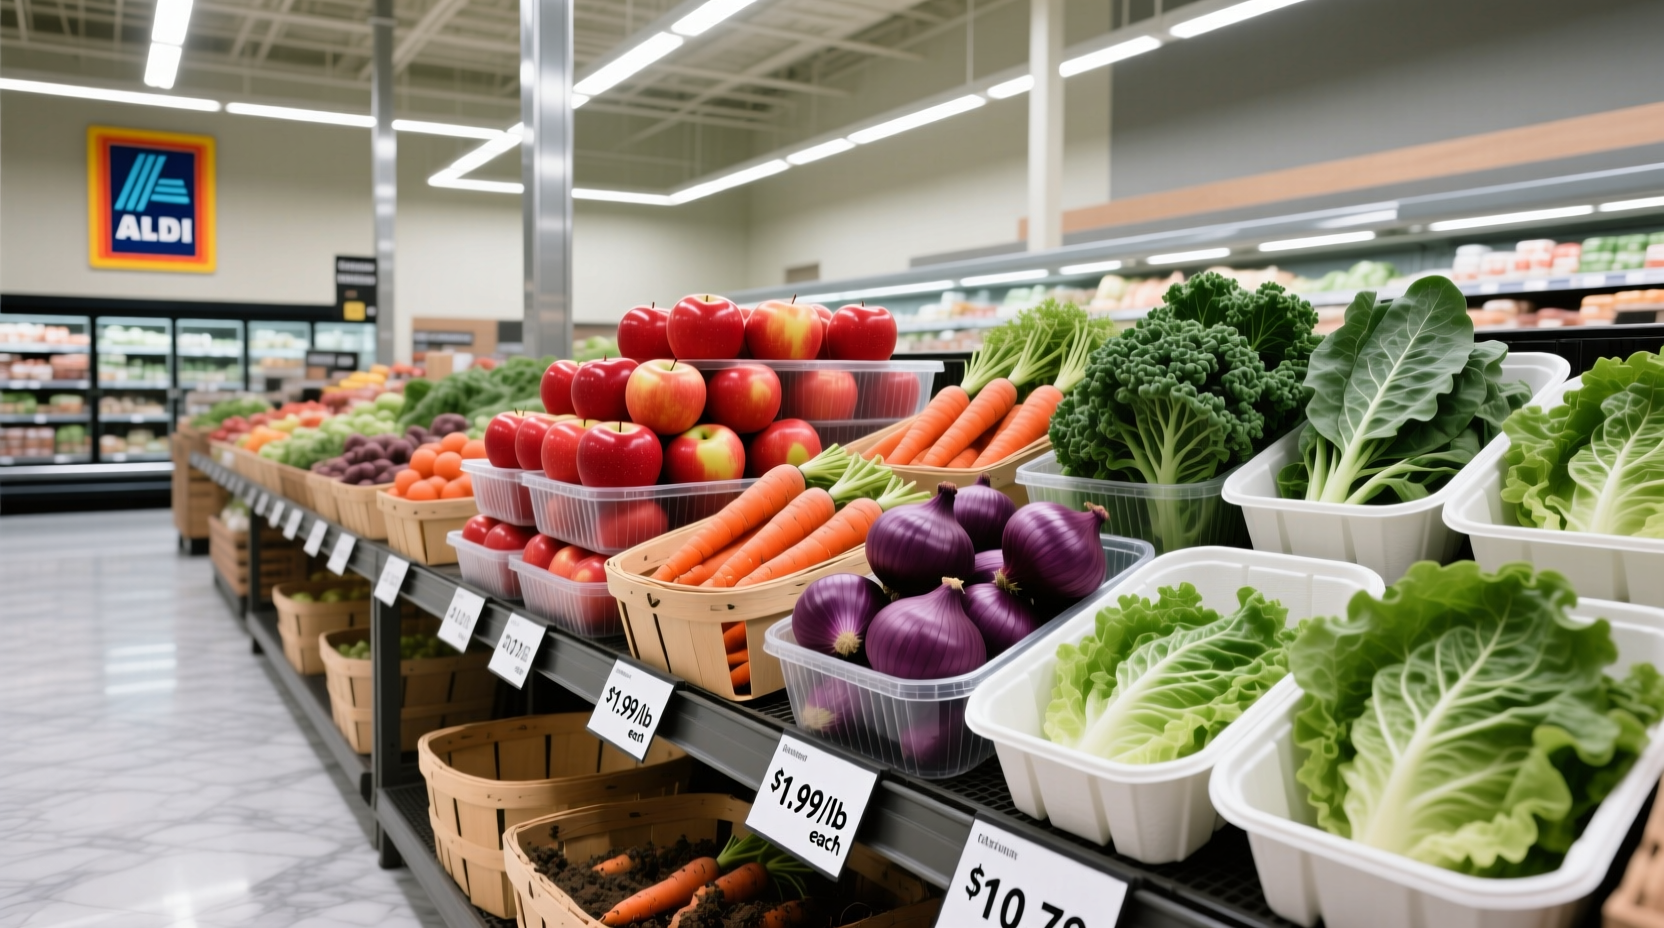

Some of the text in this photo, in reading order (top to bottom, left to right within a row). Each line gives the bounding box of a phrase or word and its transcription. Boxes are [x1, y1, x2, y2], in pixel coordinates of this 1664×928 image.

[115, 214, 192, 244] ALDI
[771, 767, 847, 830] $1.99/lb
[809, 830, 841, 856] each
